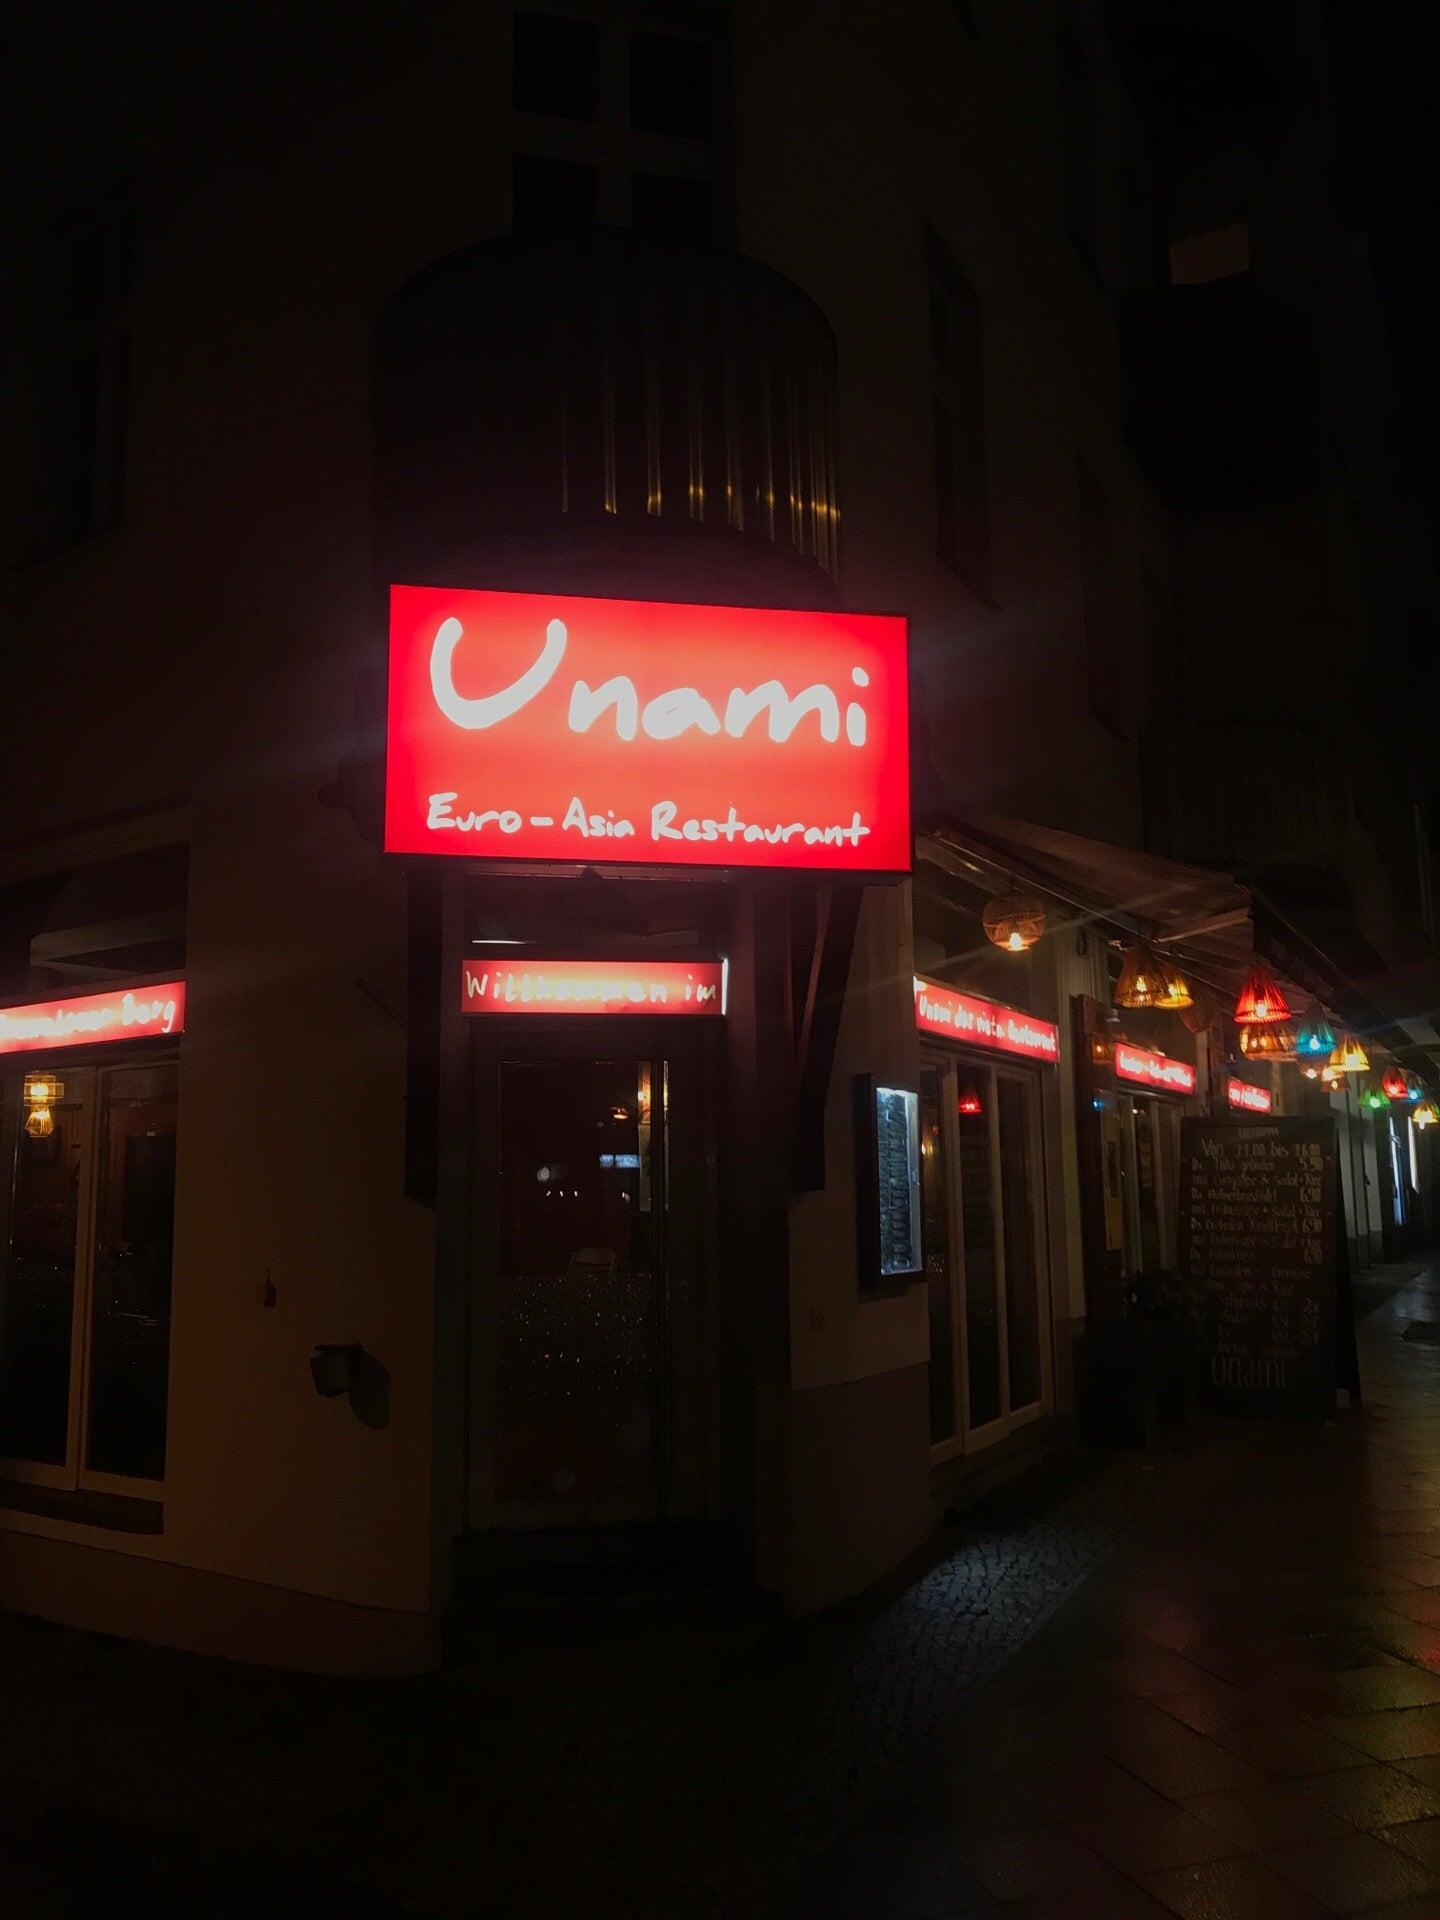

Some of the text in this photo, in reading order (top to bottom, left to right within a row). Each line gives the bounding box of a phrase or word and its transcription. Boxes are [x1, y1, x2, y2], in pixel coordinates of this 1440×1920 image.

[430, 616, 870, 747] Unami
[650, 800, 871, 847] Restaurant
[685, 973, 716, 1002] im
